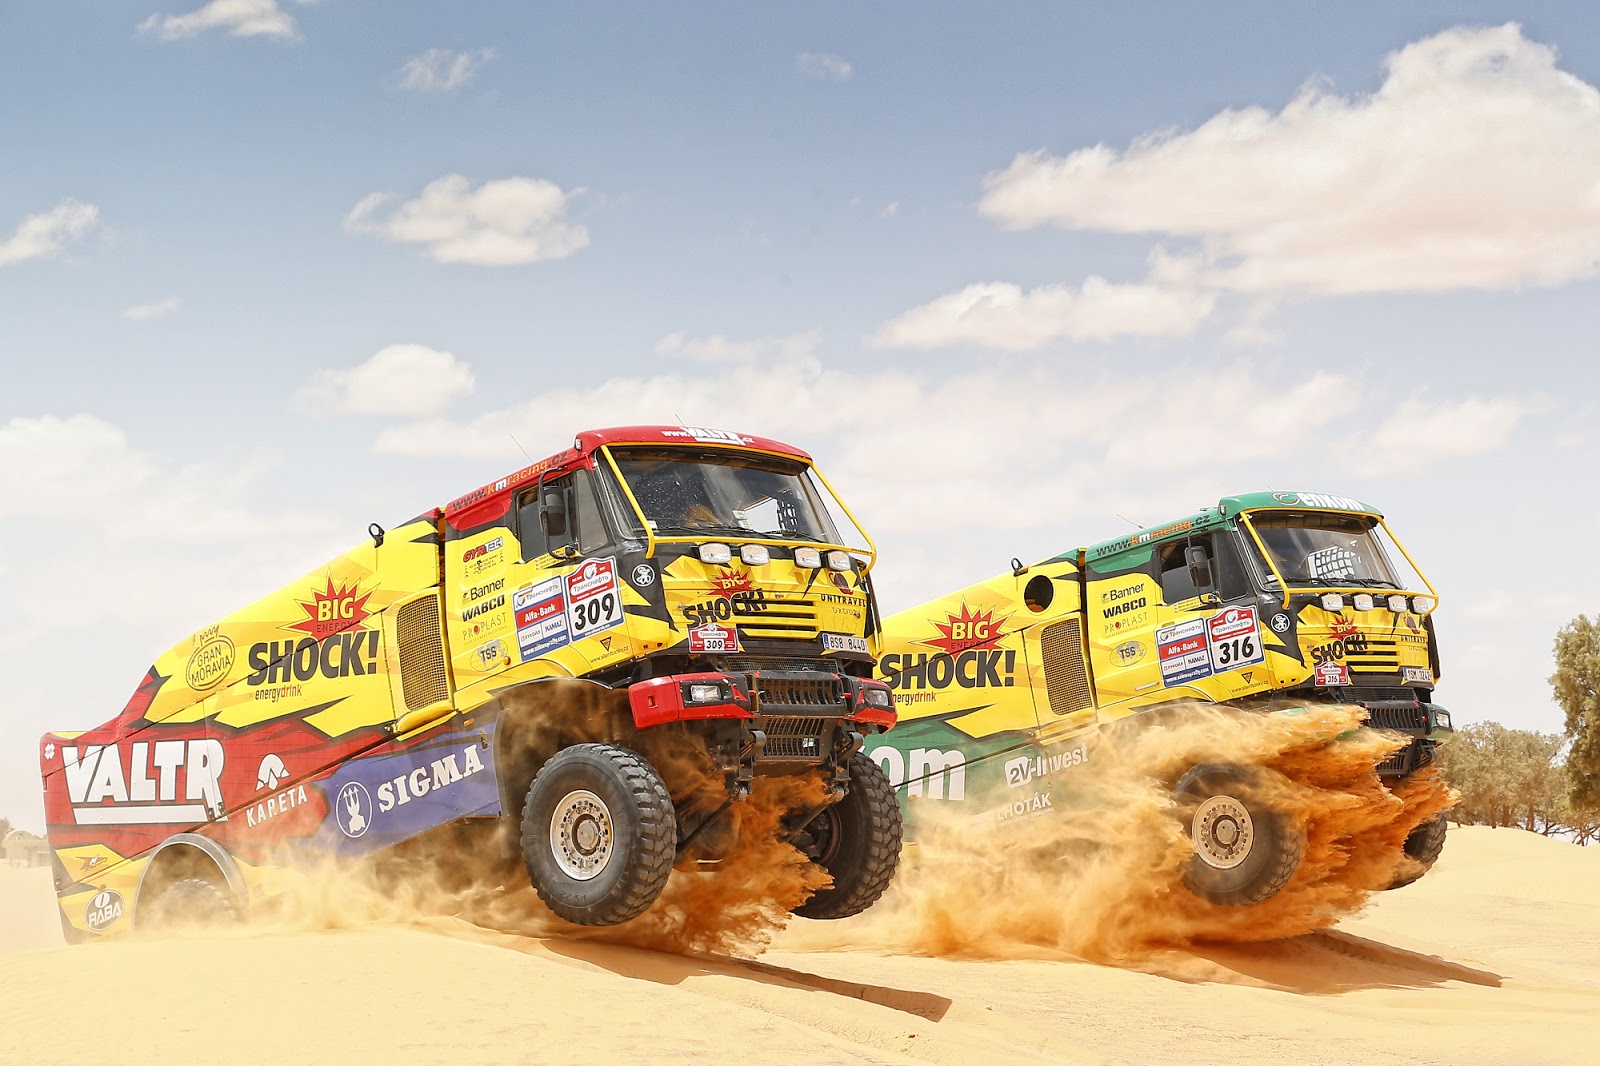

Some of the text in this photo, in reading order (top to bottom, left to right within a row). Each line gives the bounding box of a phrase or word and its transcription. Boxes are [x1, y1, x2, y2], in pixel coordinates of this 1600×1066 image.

[452, 451, 568, 511] www.kmracing.cz
[1096, 514, 1210, 556] www.kmracing.cz
[470, 578, 506, 601] Banner
[720, 575, 744, 589] BIG
[1110, 583, 1145, 601] Banner
[317, 597, 354, 622] BIG
[462, 595, 505, 622] WABCO
[574, 592, 615, 631] 309
[683, 587, 768, 629] SHOCK!
[1103, 597, 1147, 619] WABCO
[317, 621, 354, 633] ENERGY
[462, 612, 507, 640] PROPLAST
[952, 621, 989, 640] BIG
[1104, 612, 1148, 634] PROPLAST
[1337, 621, 1352, 633] BIG
[197, 644, 222, 667] GRAN
[480, 646, 497, 661] TSS
[706, 640, 723, 649] 309
[1120, 646, 1136, 659] TSS
[1219, 636, 1254, 665] 316
[1310, 631, 1368, 667] SHOCK!
[191, 655, 231, 686] MORAVIA
[247, 630, 381, 686] SHOCK!
[880, 650, 1016, 690] SHOCK!
[1327, 675, 1338, 683] 316
[255, 684, 302, 703] energydrink
[893, 691, 936, 706] nergydrink
[62, 738, 229, 825] VALTR
[377, 744, 485, 813] SIGMA
[866, 746, 966, 802] om
[245, 785, 308, 828] KARETA
[89, 901, 122, 928] RABA
